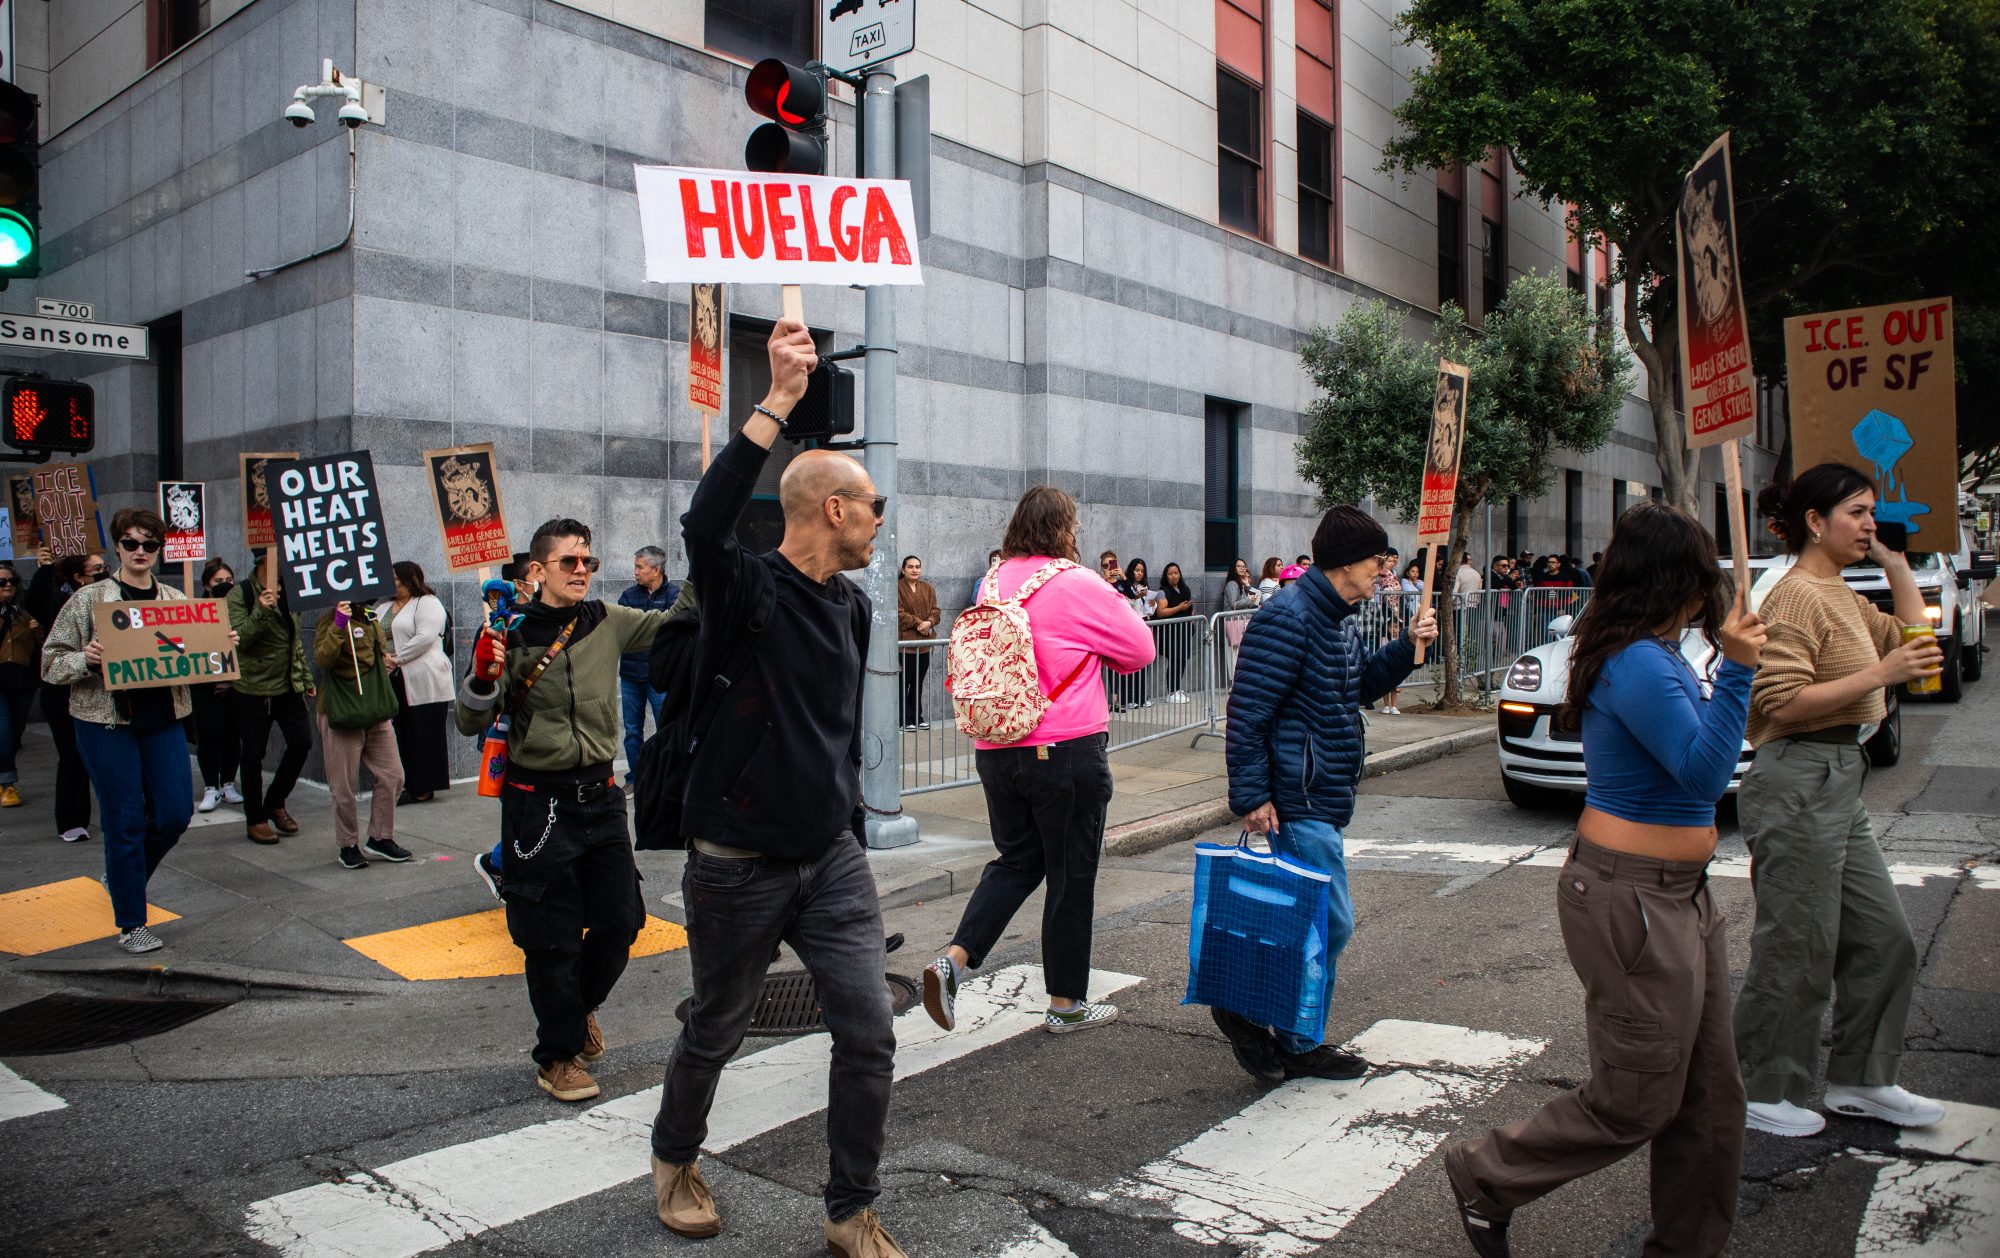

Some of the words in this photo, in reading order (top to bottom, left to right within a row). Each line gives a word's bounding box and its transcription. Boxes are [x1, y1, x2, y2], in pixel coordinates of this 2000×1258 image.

[855, 29, 880, 48] TAXI
[679, 178, 912, 265] HUELGA
[58, 303, 88, 318] 700
[1, 320, 129, 349] Sansome
[1803, 316, 1869, 352] I.C.E.
[1883, 303, 1948, 345] OUT
[1826, 356, 1868, 391] OF
[1884, 350, 1933, 390] SF
[36, 467, 80, 494] ICE
[280, 460, 364, 496] OUR
[40, 489, 86, 520] OUT
[281, 489, 369, 528] HEAT
[43, 516, 85, 539] THE
[283, 522, 378, 562] MELTS
[447, 533, 474, 546] HUELGA
[476, 528, 504, 542] GENERAL
[51, 536, 86, 558] BAY
[452, 553, 483, 566] GENERAL
[485, 546, 508, 560] STRIKE
[294, 554, 379, 597] ICE
[112, 602, 220, 630] OBEDIENCE
[108, 650, 236, 685] PATRIOTISM
